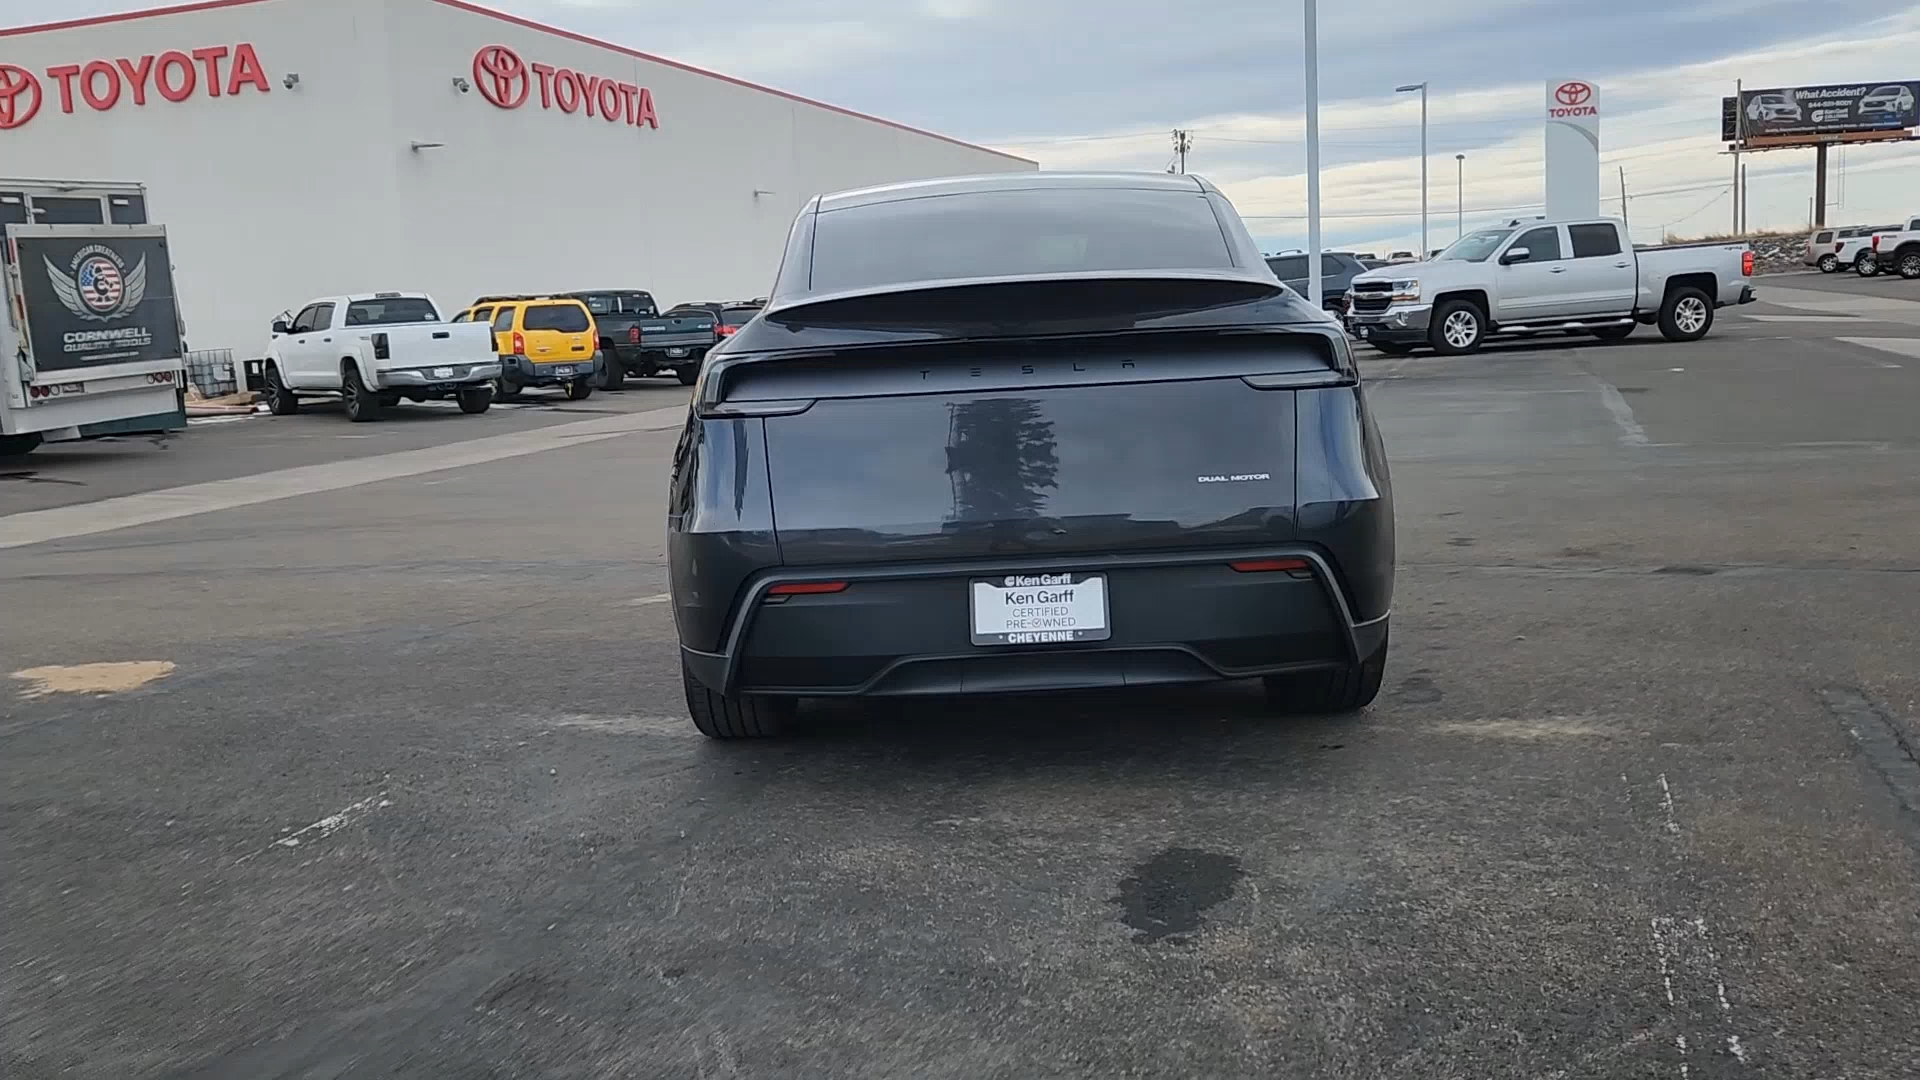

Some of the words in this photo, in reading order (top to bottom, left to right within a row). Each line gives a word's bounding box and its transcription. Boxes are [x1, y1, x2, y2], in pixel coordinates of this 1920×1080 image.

[46, 43, 270, 113] TOYOTA
[531, 63, 658, 129] TOYOTA
[1795, 90, 1820, 99] What
[1820, 87, 1867, 98] Accident?
[1549, 106, 1597, 118] TOYOTA
[63, 327, 152, 343] CORNWELL
[63, 341, 112, 352] QUALITY
[114, 337, 152, 348] TOOLS
[919, 359, 1135, 380] TESLA
[1230, 473, 1270, 481] MOTOR
[1015, 575, 1040, 587] Ken
[1040, 573, 1071, 585] Garff
[1005, 591, 1034, 605] Ken
[1037, 589, 1074, 604] Garff
[1012, 606, 1068, 618] CERTIFIED
[1008, 630, 1074, 643] CHEYENNE
